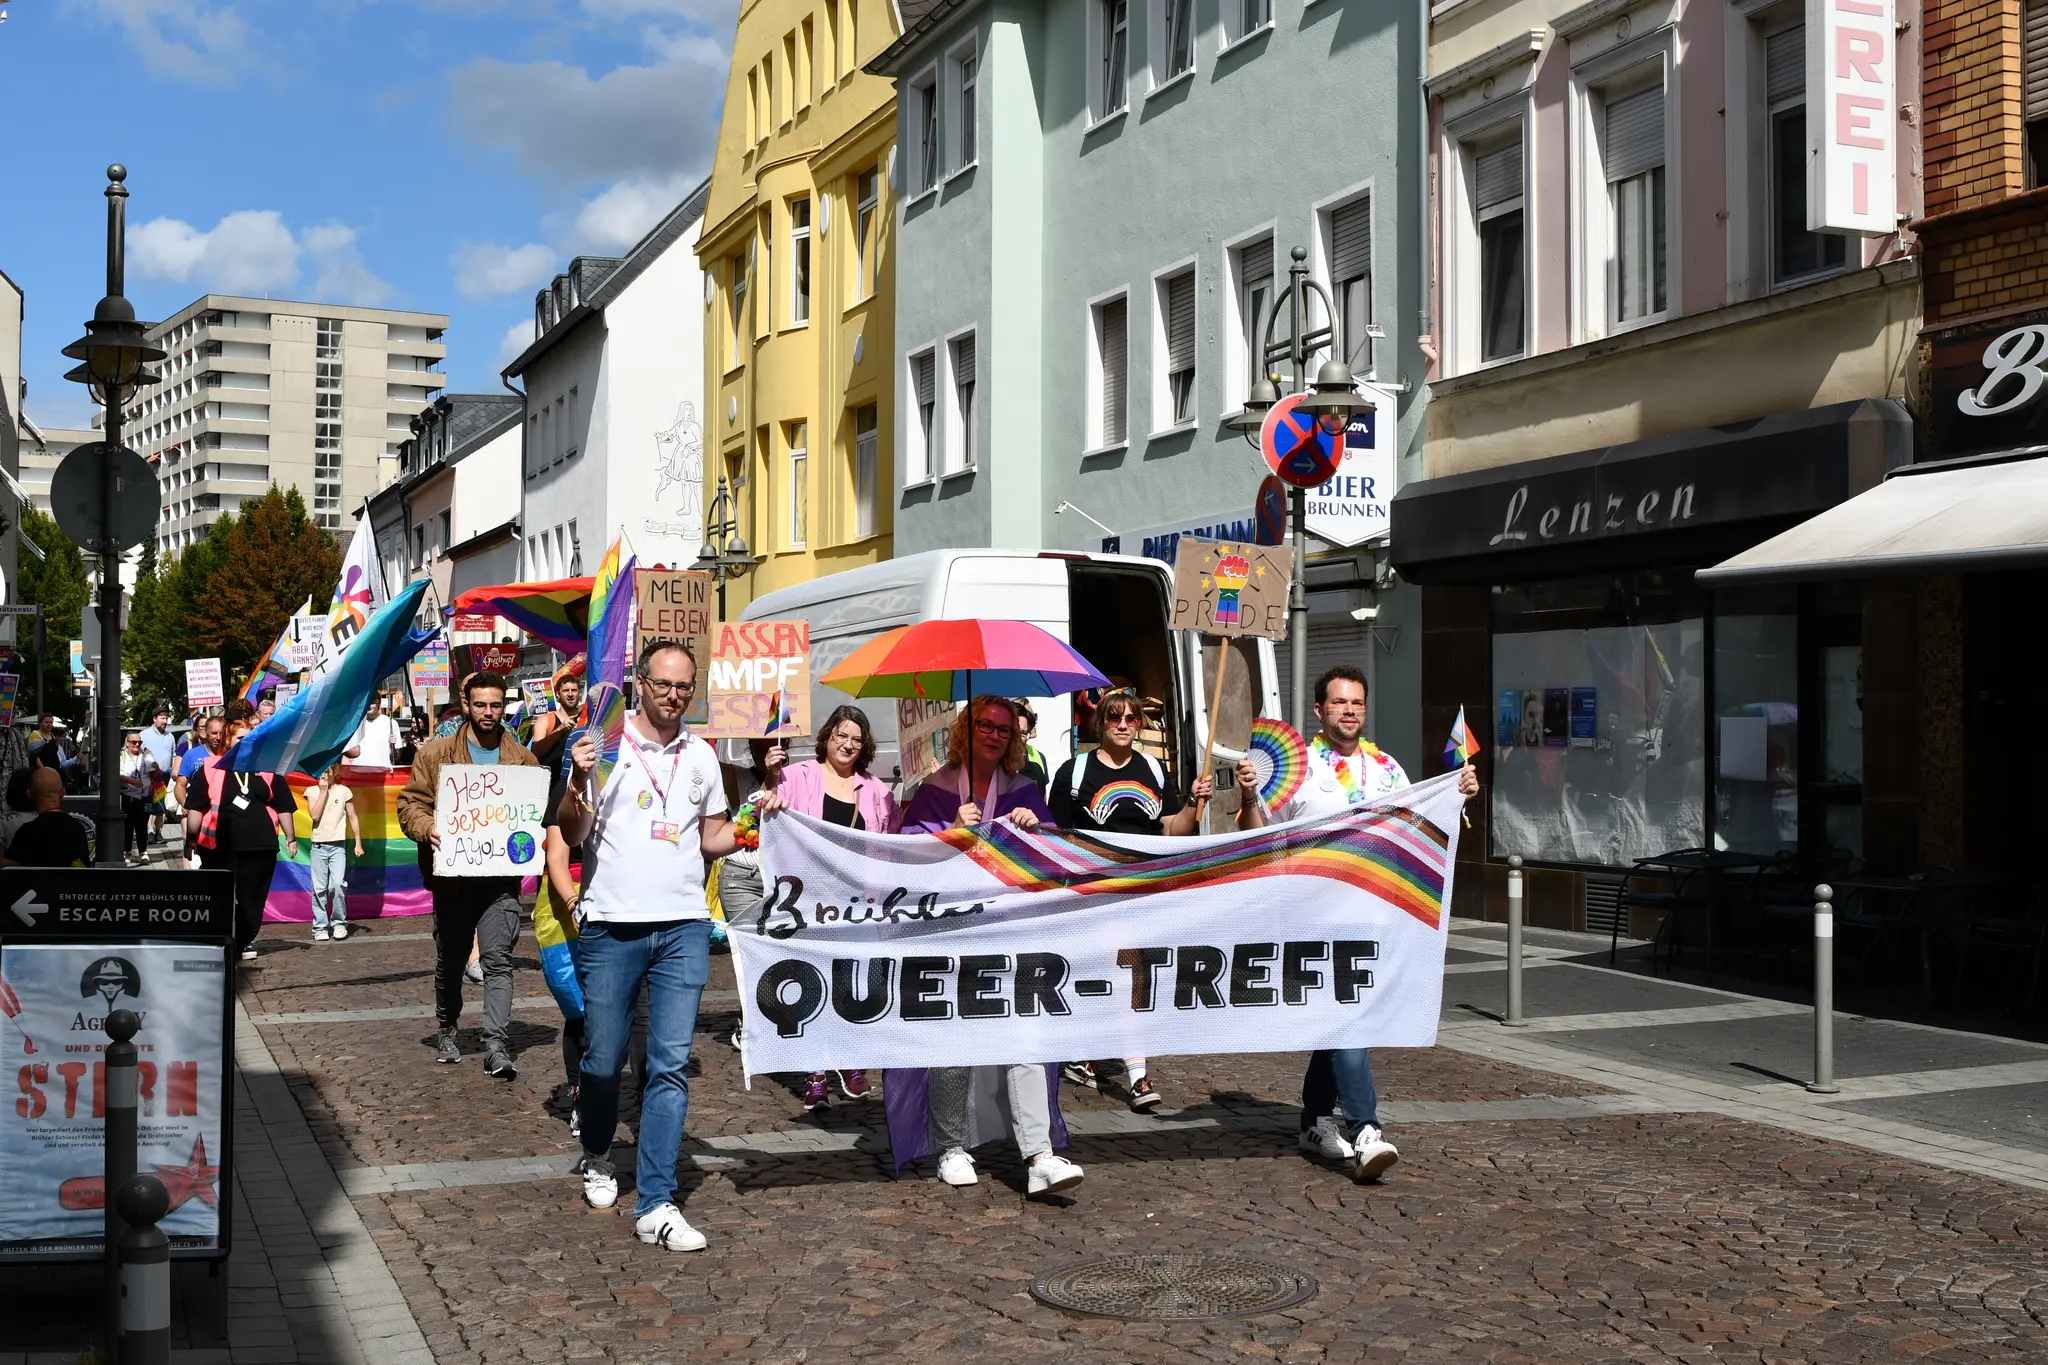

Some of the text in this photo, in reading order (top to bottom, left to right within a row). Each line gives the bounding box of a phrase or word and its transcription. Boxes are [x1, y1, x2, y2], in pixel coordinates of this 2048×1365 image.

[1834, 0, 1885, 216] REI
[1318, 475, 1376, 499] BIER
[1307, 501, 1386, 518] BRUNNEN
[1489, 482, 1696, 547] Lenzen
[651, 579, 705, 604] MEIN
[639, 608, 708, 635] LEBEN
[1173, 598, 1282, 632] PRIDE
[292, 645, 308, 654] ABER
[712, 622, 810, 659] ASSEN
[708, 657, 804, 692] AMPF
[688, 693, 799, 736] ESBE
[59, 893, 107, 901] ENTDECKE
[139, 892, 175, 901] BRÜHLS
[177, 894, 211, 902] ERSTEN
[59, 907, 210, 922] ESCAPE ROOM
[755, 940, 1379, 1039] QUEER-TREFF
[65, 1044, 154, 1052] UND DE OTE
[54, 1243, 85, 1251] BRÜHLER
